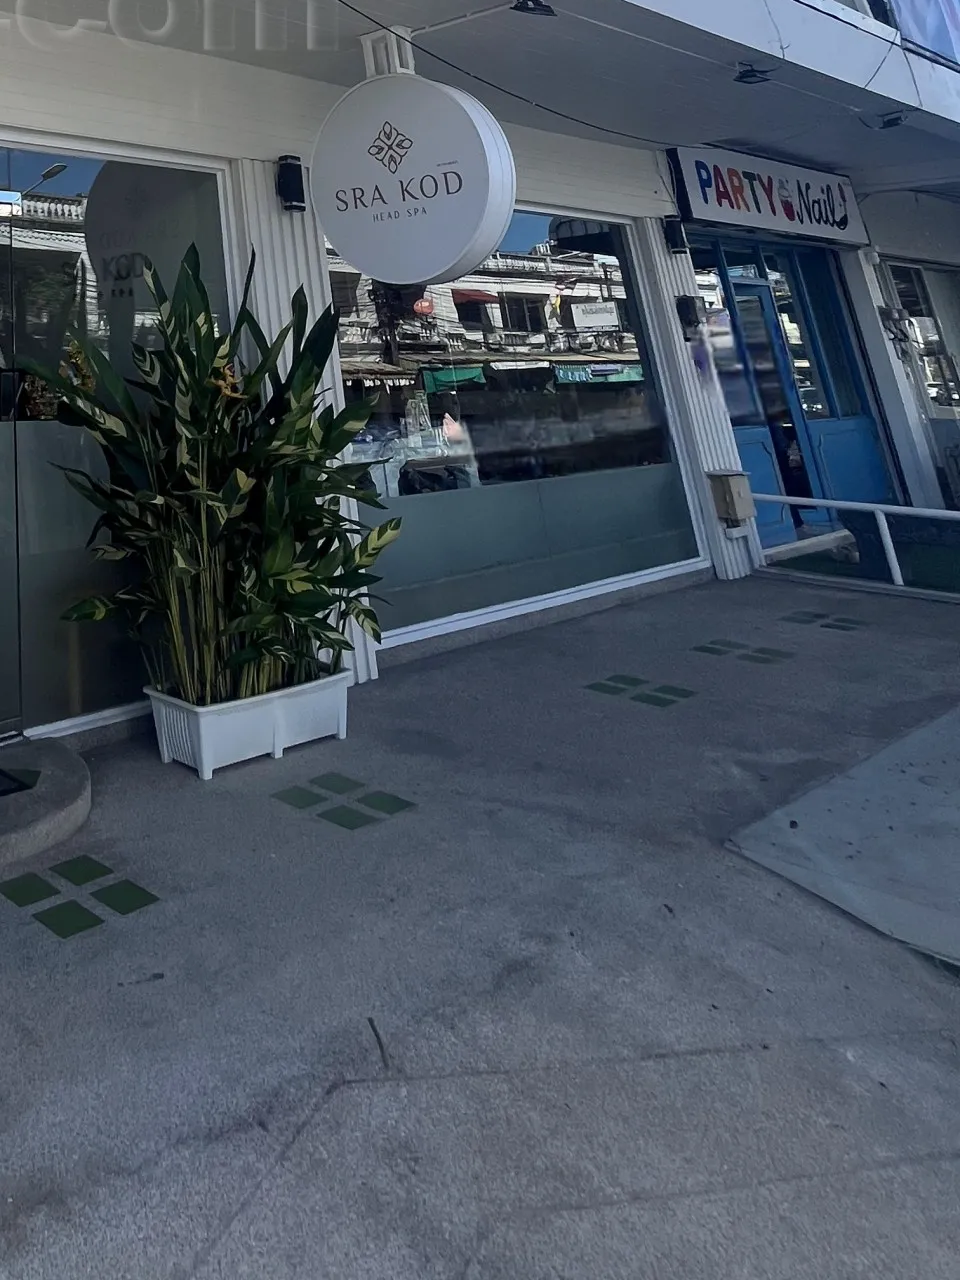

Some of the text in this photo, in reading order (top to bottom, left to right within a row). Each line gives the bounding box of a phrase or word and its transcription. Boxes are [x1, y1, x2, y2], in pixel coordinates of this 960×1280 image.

[335, 171, 463, 212] SRA KOD
[694, 159, 840, 228] PARTY Nail
[372, 206, 427, 223] HEAD SPA
